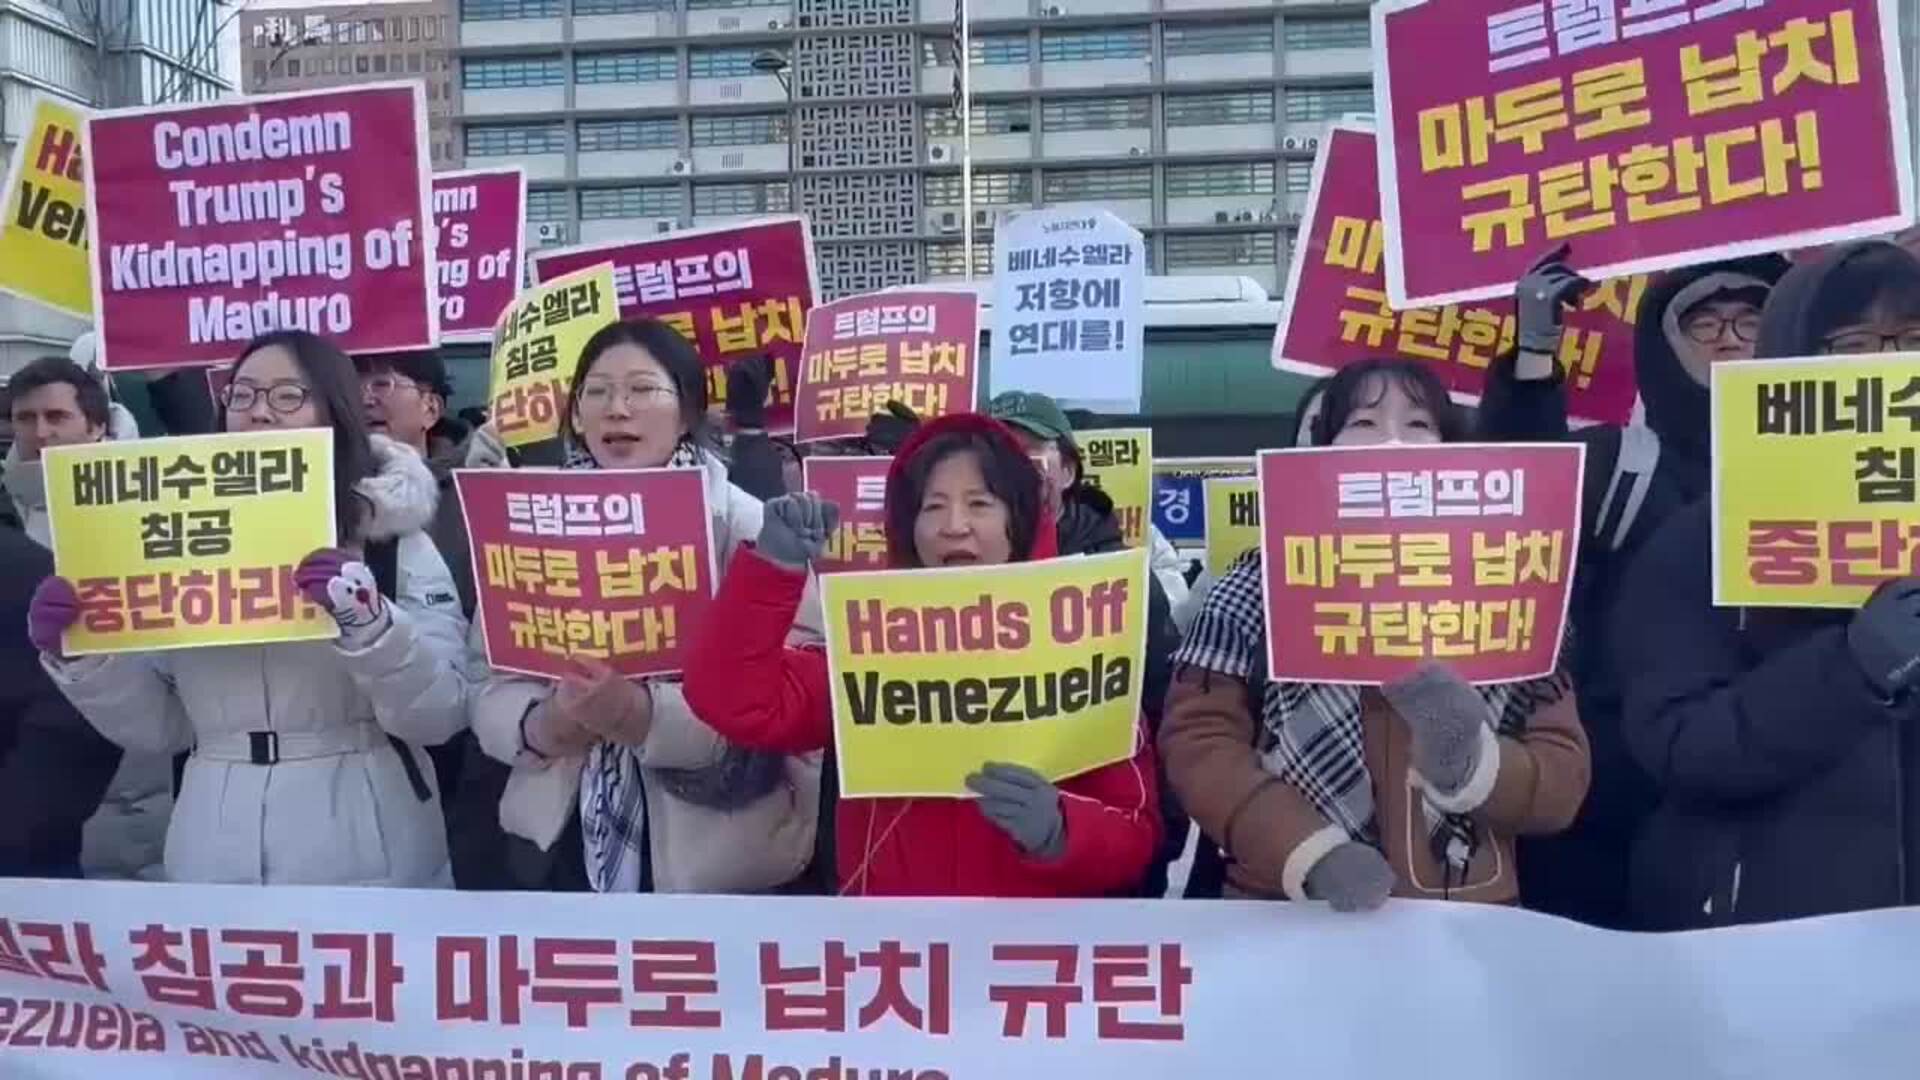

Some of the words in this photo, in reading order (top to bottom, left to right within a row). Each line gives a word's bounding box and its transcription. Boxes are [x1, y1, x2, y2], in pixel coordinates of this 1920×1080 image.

[1487, 0, 1765, 73] 트럼프
[1418, 57, 1652, 173] 마두로
[1680, 9, 1861, 115] 납치
[153, 111, 351, 169] Condemn
[169, 165, 345, 227] Trump's
[1461, 110, 1824, 252] 규탄한다!
[110, 230, 351, 290] Kidnapping
[364, 219, 414, 270] of
[478, 248, 511, 281] of
[614, 248, 753, 306] 트럼프의
[1008, 244, 1133, 273] 베네수엘라
[188, 291, 352, 343] Maduro
[833, 305, 936, 340] 트럼프의
[1015, 278, 1121, 312] 저항에
[711, 296, 806, 353] 납치
[1008, 320, 1125, 357] 연대를!
[505, 335, 558, 381] 침공
[807, 343, 889, 385] 마두로
[900, 341, 967, 378] 납치
[816, 382, 948, 422] 규탄한다!
[72, 447, 309, 507] 베네수엘라
[1337, 468, 1525, 519] 트럼프의
[1855, 446, 1916, 504] 침
[141, 509, 233, 560] 침공
[505, 492, 646, 537] 트럼프의
[1158, 487, 1191, 525] 경
[483, 543, 582, 598] 마두로
[595, 544, 698, 599] 납치
[1283, 532, 1453, 589] 마두로
[1471, 529, 1564, 587] 납치
[1747, 519, 1920, 587] 중단
[506, 601, 677, 660] 규탄한다!
[844, 594, 1031, 656] Hands
[1049, 578, 1130, 643] Off
[1313, 597, 1537, 657] 규탄한다!
[841, 653, 1132, 726] Venezuela
[128, 923, 405, 1024] 침공과
[435, 933, 723, 1028] 마두로
[759, 940, 950, 1035] 납치
[988, 943, 1194, 1041] 규탄
[175, 1020, 280, 1063] and
